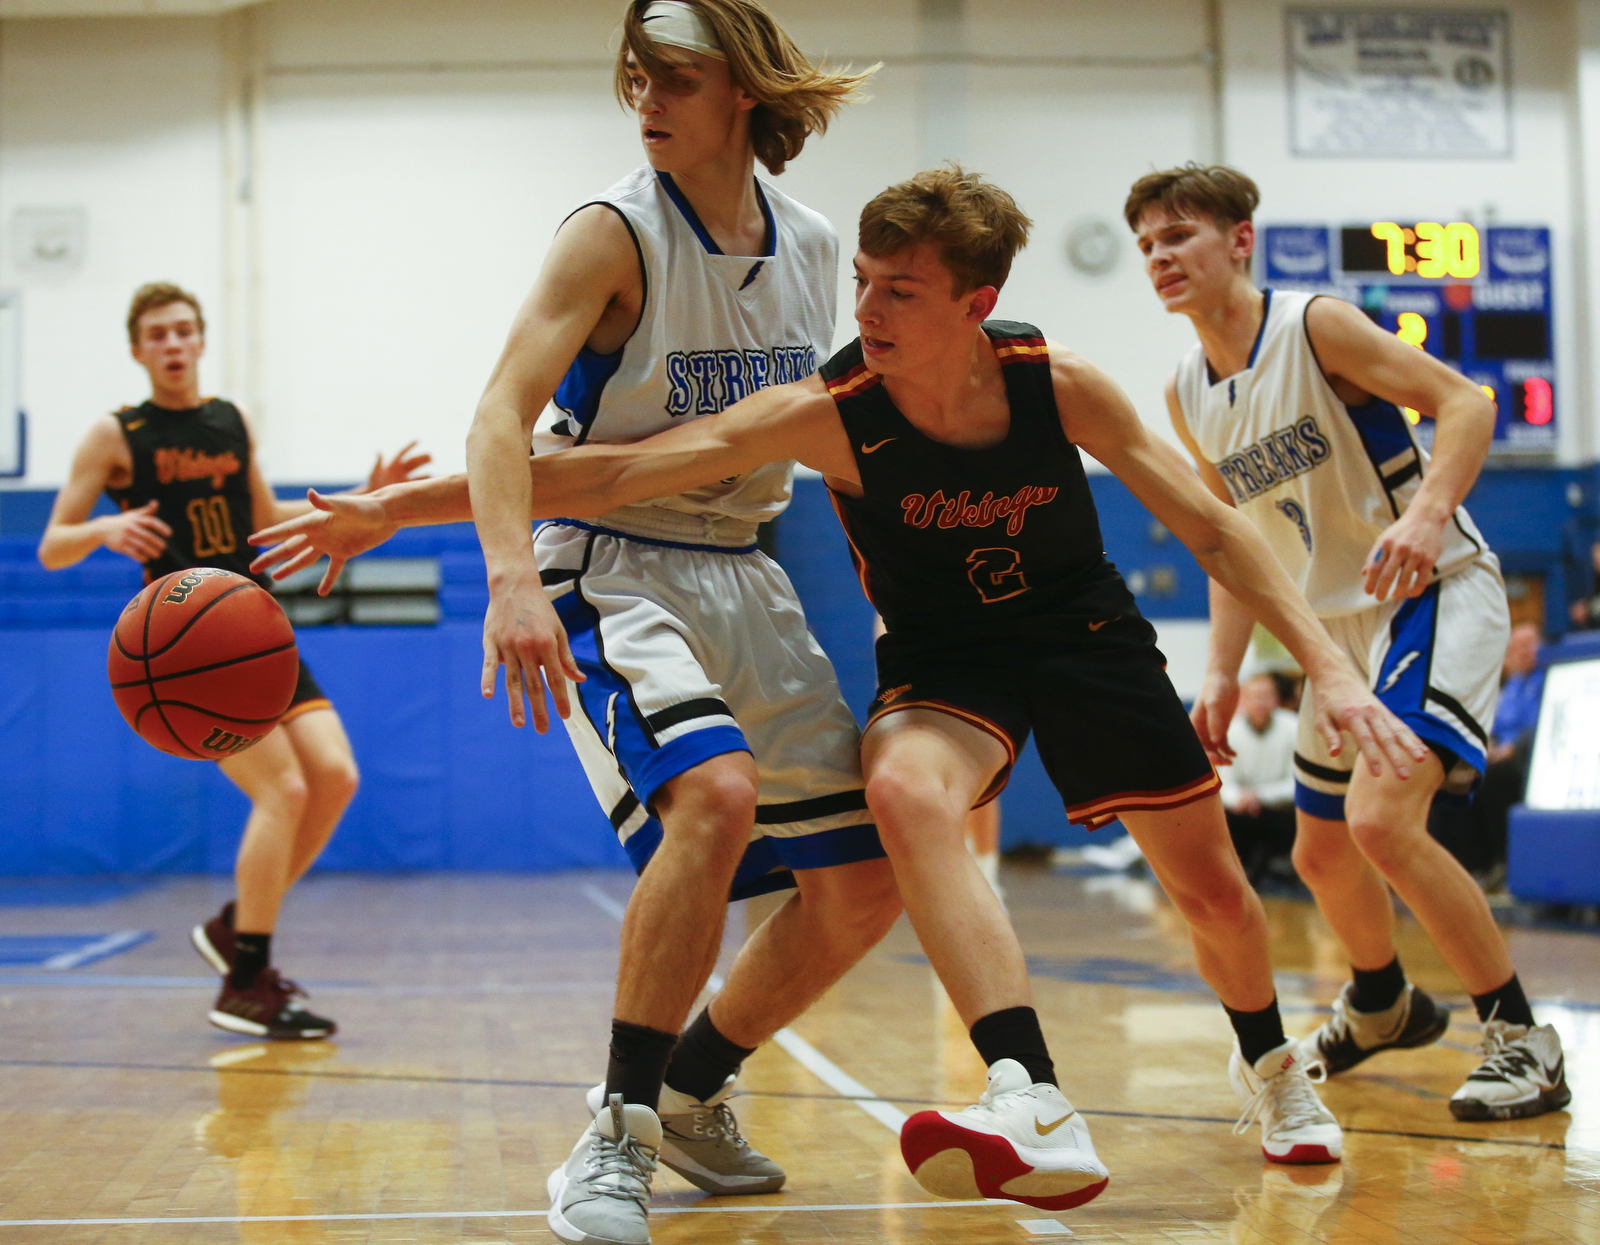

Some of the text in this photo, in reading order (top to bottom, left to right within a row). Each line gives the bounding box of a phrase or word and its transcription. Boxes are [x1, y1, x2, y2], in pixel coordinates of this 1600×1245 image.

[1371, 222, 1480, 278] 7:30
[1214, 415, 1332, 505] TREAKS
[901, 485, 1058, 536] Vikings
[966, 547, 1031, 604] 2
[201, 726, 264, 755] Wil
